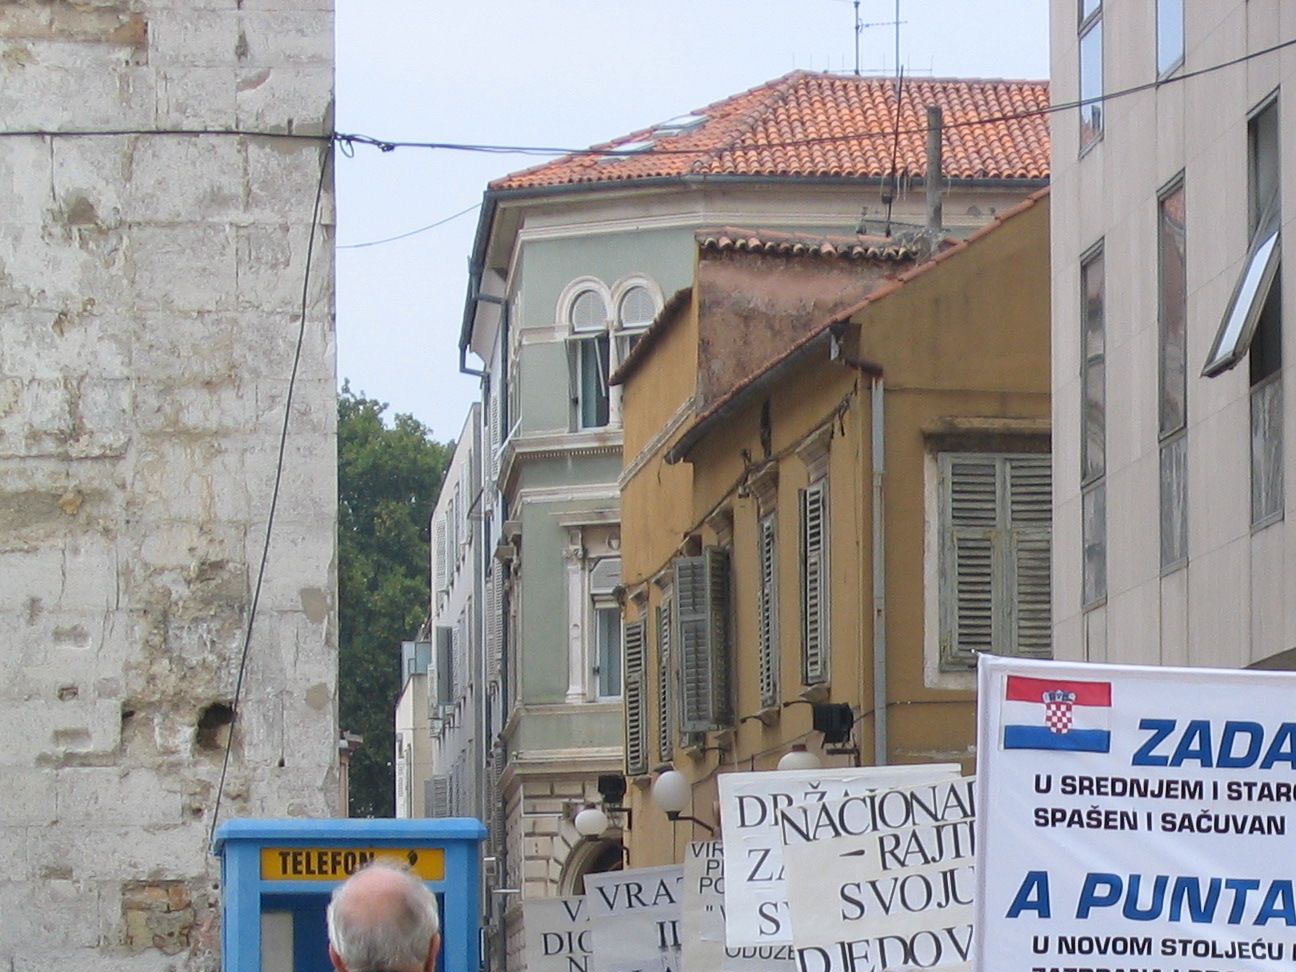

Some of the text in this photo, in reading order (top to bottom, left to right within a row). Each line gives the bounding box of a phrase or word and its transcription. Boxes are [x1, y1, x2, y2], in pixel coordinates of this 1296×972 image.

[1034, 774, 1052, 794] U
[1060, 776, 1203, 801] SREDNJEM
[1212, 780, 1219, 800] I
[1034, 804, 1286, 835] SPAŠEN I SAČUVAN
[596, 876, 684, 911] VRA
[1006, 870, 1051, 919] A
[1033, 936, 1049, 954] U
[1057, 937, 1152, 957] NOVOM
[1161, 935, 1284, 961] STOLJEĆU
